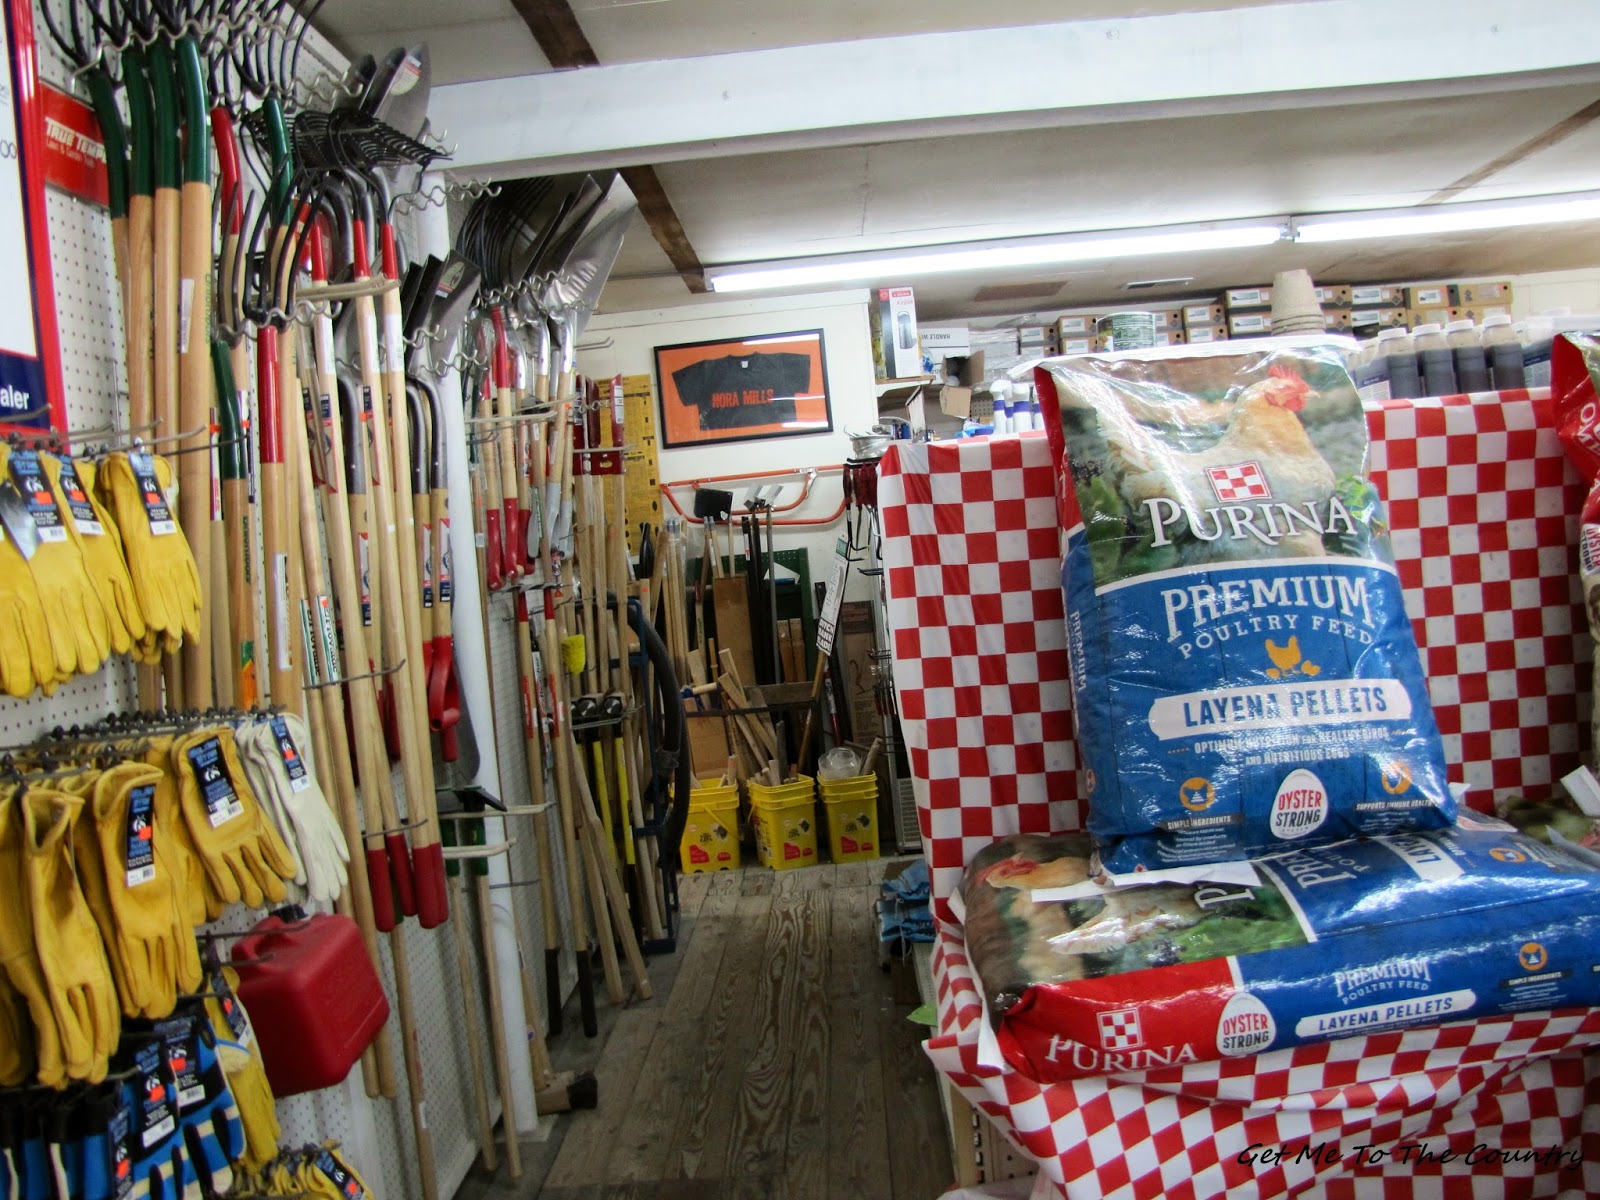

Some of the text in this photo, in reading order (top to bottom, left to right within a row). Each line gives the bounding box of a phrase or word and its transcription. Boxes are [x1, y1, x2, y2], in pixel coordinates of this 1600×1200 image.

[75, 131, 107, 164] TEMP
[0, 384, 29, 410] aler
[711, 388, 774, 408] NORA MILLS
[1142, 496, 1358, 548] PURINA
[1160, 575, 1376, 643] PREMIUM
[1069, 609, 1088, 692] PREMIUM
[1178, 614, 1374, 660] POULTRY FEED
[1183, 686, 1388, 728] LAYENA PELLETS
[1278, 789, 1322, 811] OYSTER
[1355, 801, 1385, 811] SUPPORTS
[1167, 815, 1232, 830] SIMPLE INGREDIENTS
[1275, 809, 1321, 827] STRONG
[1391, 836, 1442, 864] LAYE
[1332, 959, 1431, 998] PREMIUM
[1342, 980, 1429, 1005] POULTRY FEED
[1223, 1013, 1268, 1036] OYSTER
[1319, 1010, 1379, 1032] LAYENA
[1386, 997, 1453, 1020] PELLETS
[1044, 1033, 1199, 1072] PURINA
[1223, 1031, 1270, 1049] STRONG
